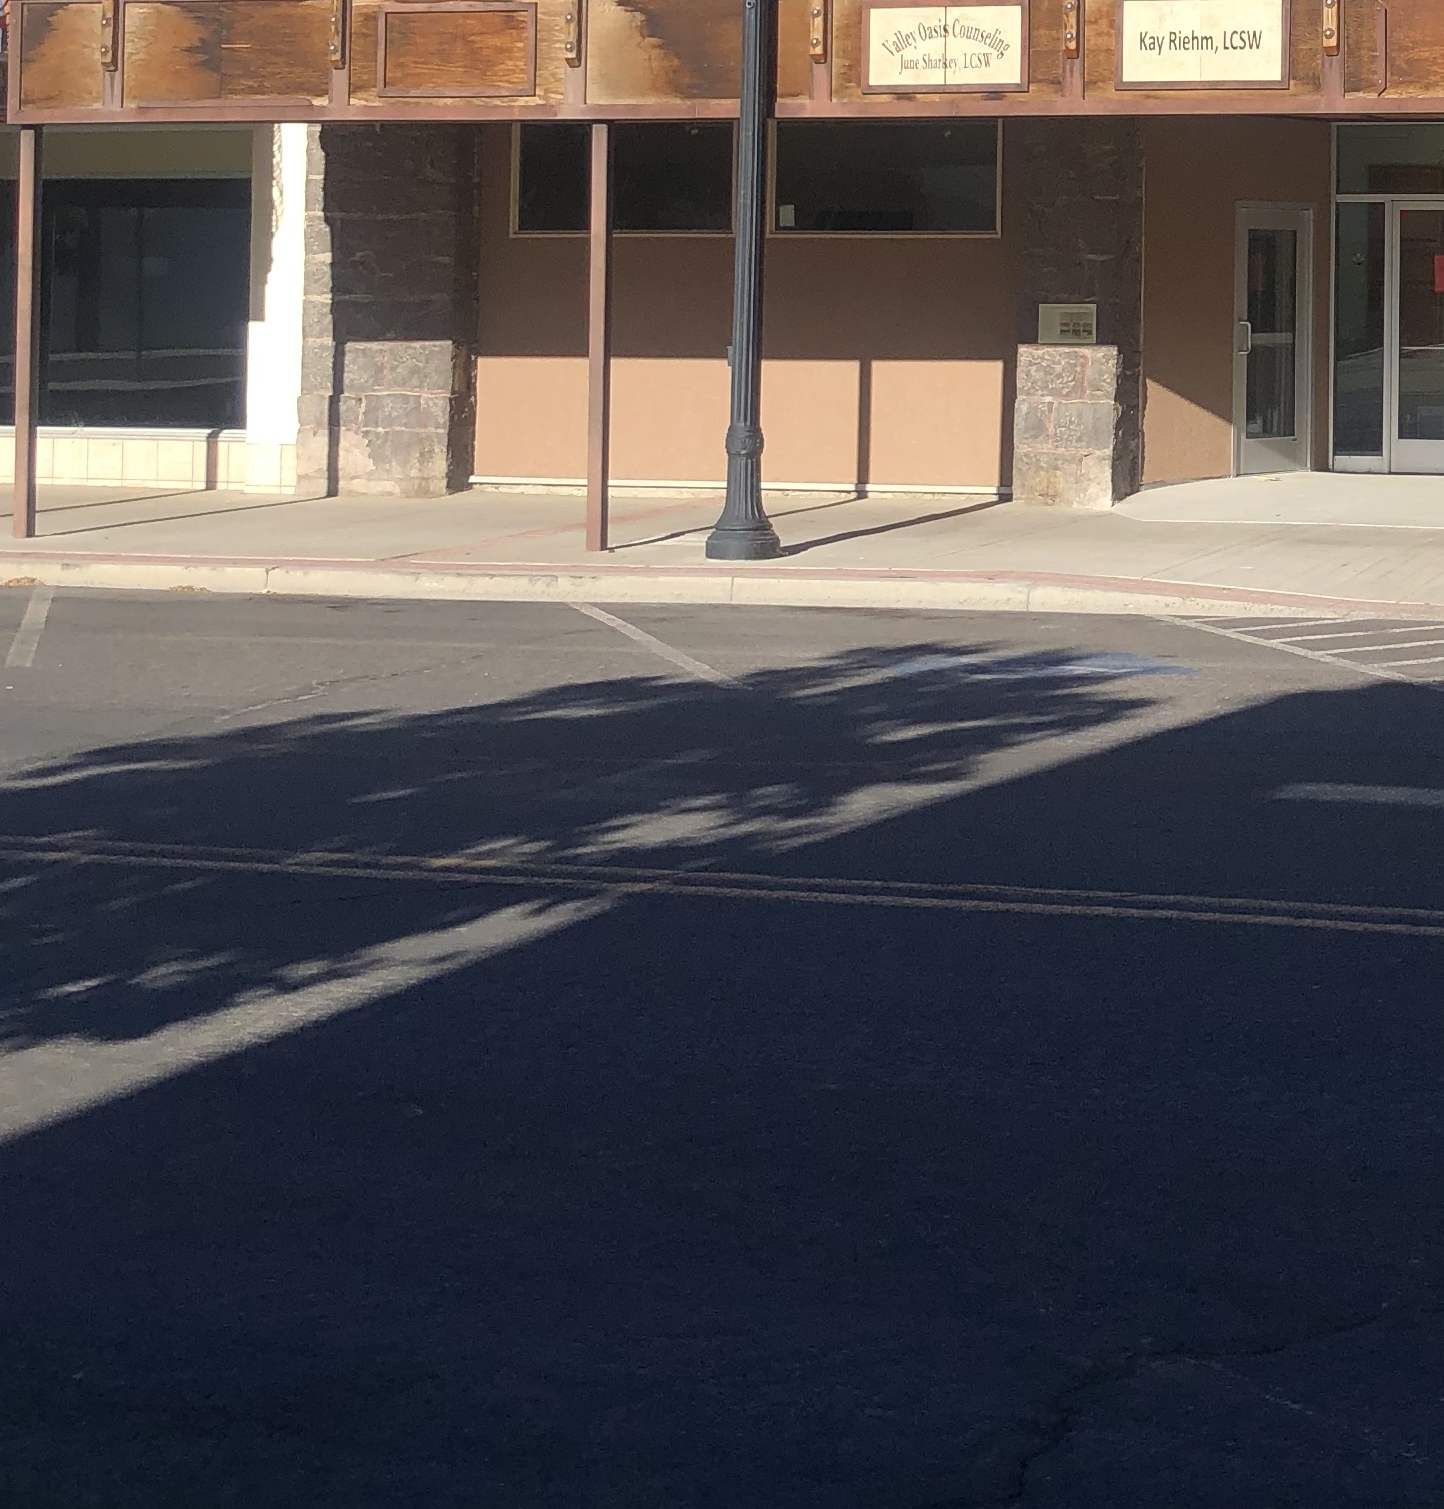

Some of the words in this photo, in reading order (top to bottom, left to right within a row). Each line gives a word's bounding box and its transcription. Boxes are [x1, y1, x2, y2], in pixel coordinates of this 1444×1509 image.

[881, 30, 917, 57] Valley
[917, 18, 949, 41] Oasis
[952, 18, 1011, 60] Counseling
[1139, 30, 1165, 56] Kay
[1168, 29, 1219, 55] Riehm,
[1223, 29, 1263, 50] LCSW
[899, 53, 919, 75] June
[963, 52, 992, 69] LCSW
